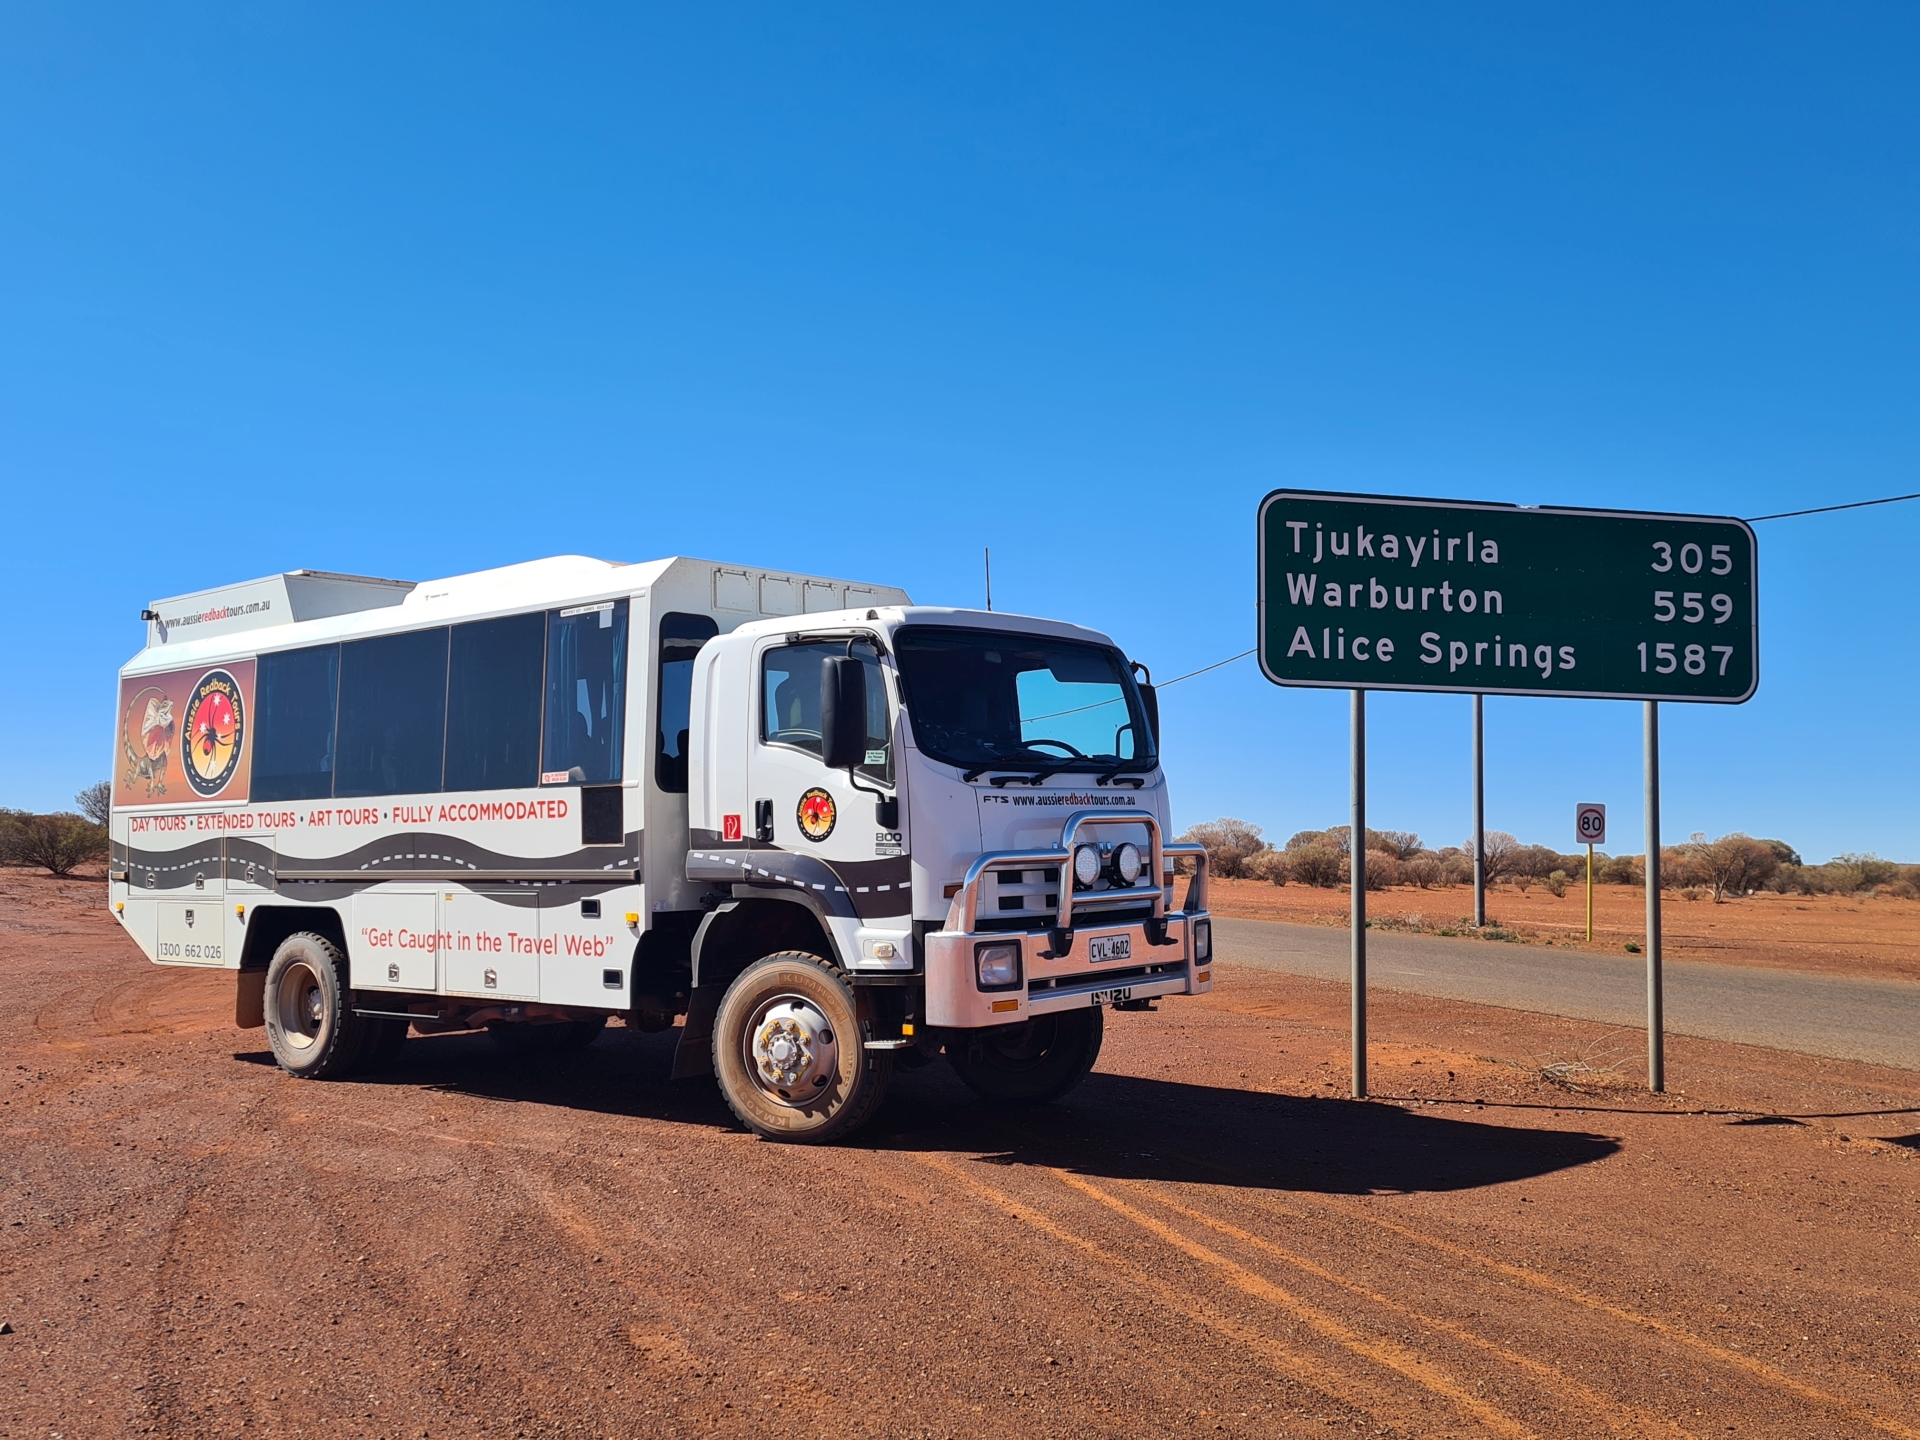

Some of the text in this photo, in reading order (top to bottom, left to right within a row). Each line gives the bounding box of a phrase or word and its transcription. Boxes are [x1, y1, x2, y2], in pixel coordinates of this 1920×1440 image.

[1286, 521, 1733, 576] Tjukayirla 305
[1286, 572, 1734, 624] Warburton 559
[164, 600, 271, 629] www.aussieredbacktours.com.au
[1287, 626, 1734, 679] Alice Springs 1587
[184, 678, 241, 740] Aussie Redback Tours
[983, 792, 1136, 806] FTS www.aussieredbacktours.com.au
[131, 800, 568, 832] DAY TOURS EXTENDED TOURS ART TOURS FULLY ACCOMMODATED
[1581, 816, 1602, 832] 80
[875, 832, 903, 842] 800
[159, 943, 222, 959] 1300 662 026
[398, 929, 453, 953] Caught
[457, 930, 471, 951] in
[476, 931, 502, 953] the
[507, 932, 558, 955] Travel
[783, 973, 836, 1005] KUMHO
